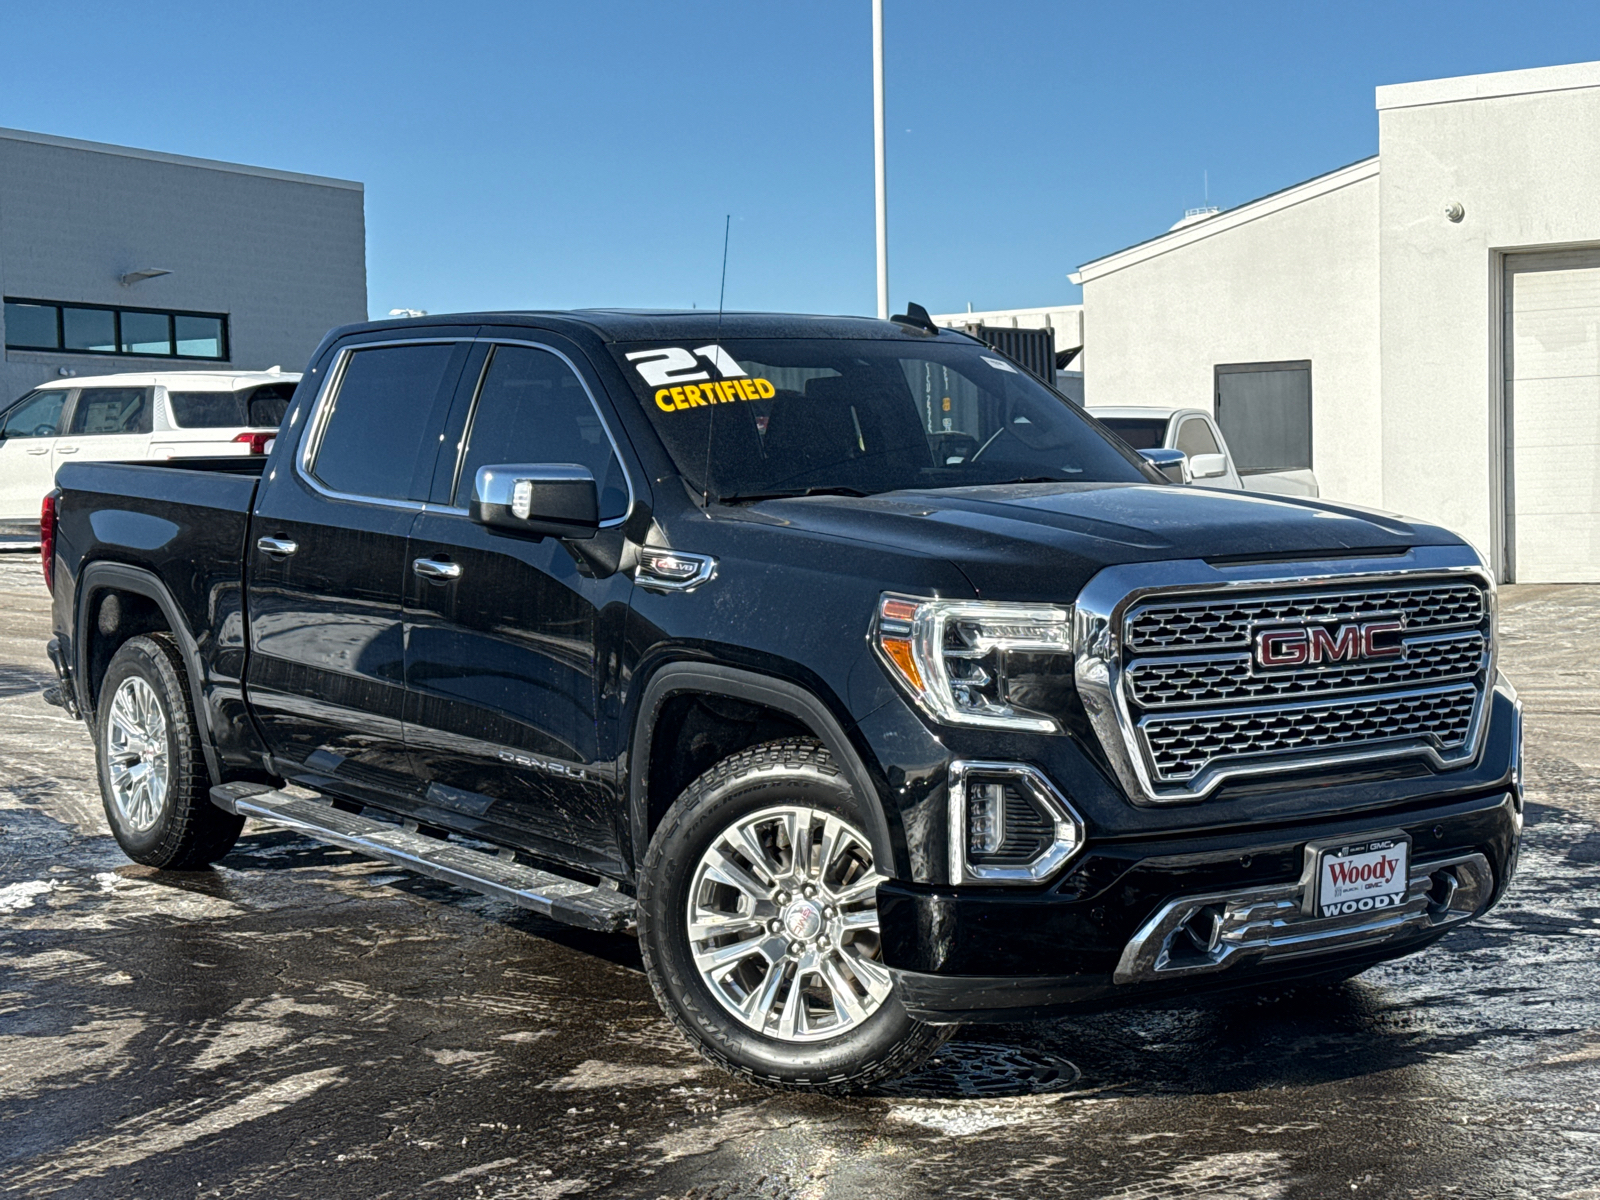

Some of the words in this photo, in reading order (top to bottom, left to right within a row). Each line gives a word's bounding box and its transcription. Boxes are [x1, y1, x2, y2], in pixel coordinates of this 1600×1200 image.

[625, 344, 748, 387] 21
[655, 377, 776, 412] CERTIFIED
[1256, 620, 1401, 667] GMC
[498, 750, 586, 780] DENALI
[1369, 841, 1391, 851] GMC
[1328, 854, 1400, 887] Woody
[1364, 881, 1383, 890] GMC
[1322, 892, 1405, 918] WOODY
[793, 907, 812, 937] GMC
